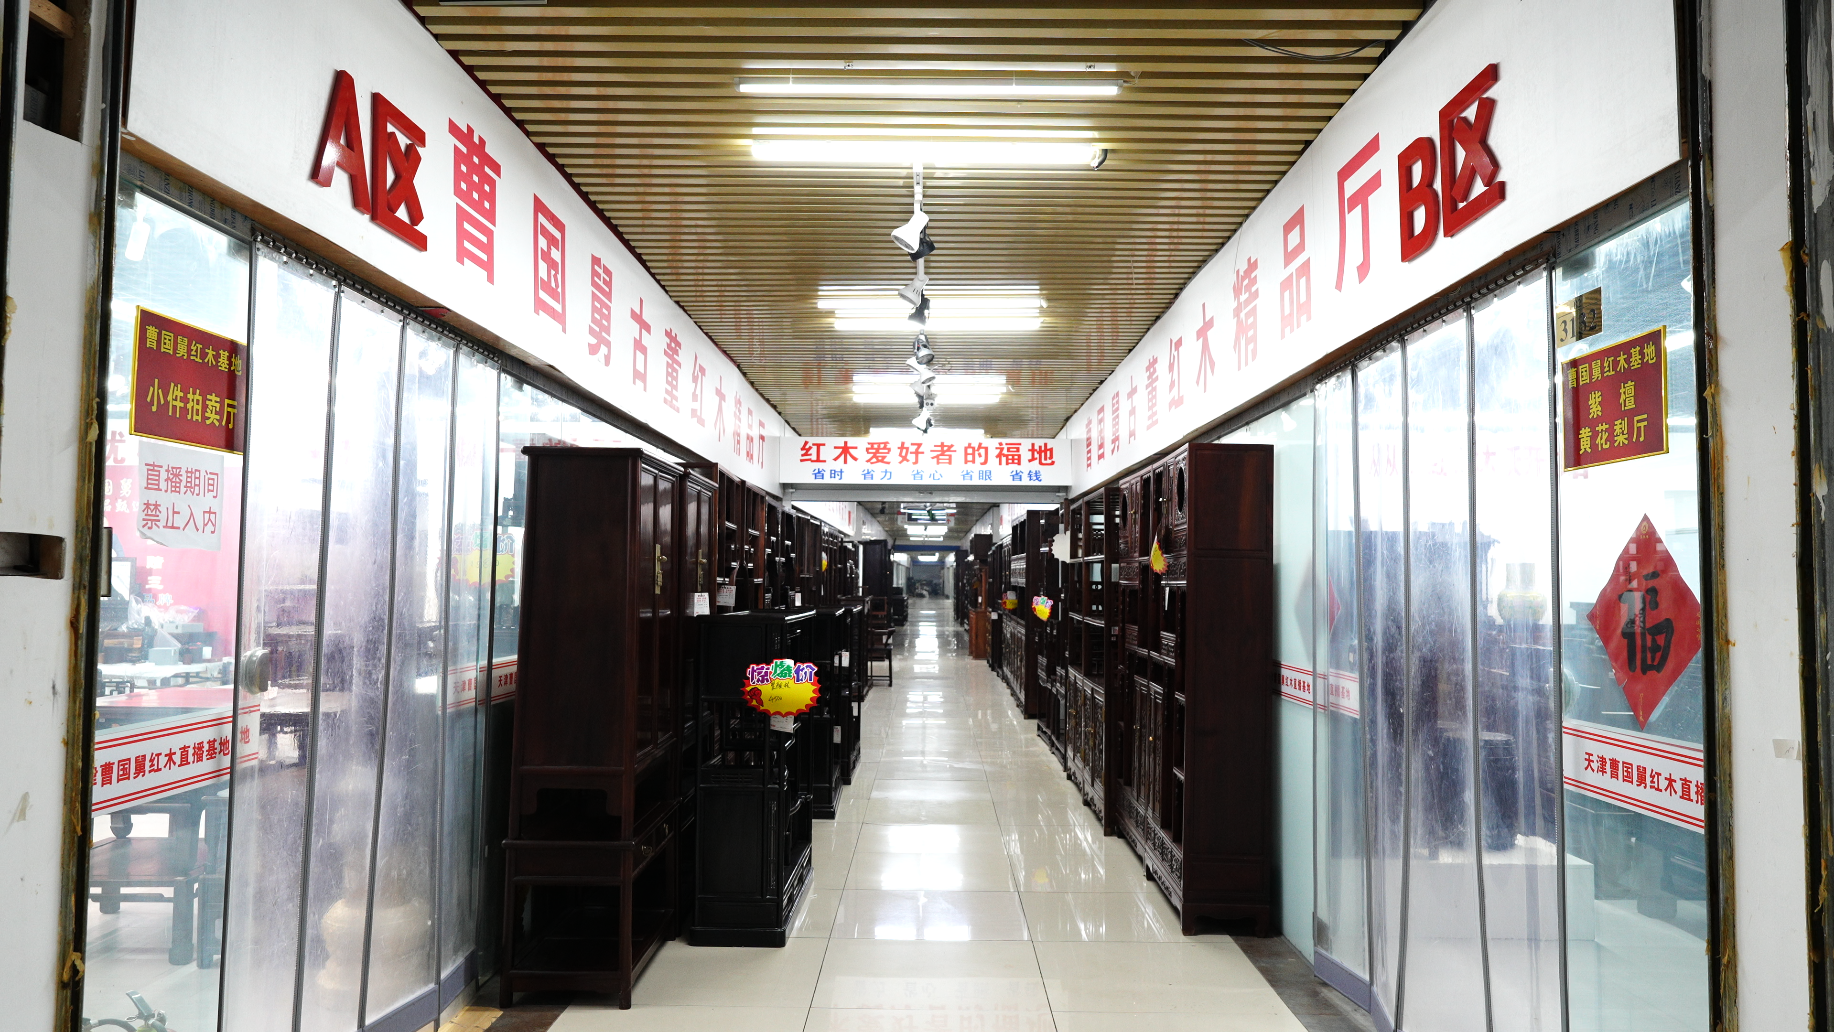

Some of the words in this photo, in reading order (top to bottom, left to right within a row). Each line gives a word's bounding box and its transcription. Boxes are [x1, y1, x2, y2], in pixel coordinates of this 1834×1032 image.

[311, 69, 428, 252] A区
[1398, 62, 1506, 263] B区
[448, 117, 765, 469] 曹国舅古董红木精品厅
[1085, 132, 1381, 472] 曹国舅古董红木精品厅
[146, 325, 242, 376] 曹国舅红木基地
[1568, 342, 1657, 389] 曹国舅红木基地
[147, 378, 238, 429] 小件拍卖厅
[800, 441, 1056, 466] 红木爱好者的福地
[1579, 414, 1648, 455] 黄花梨厅
[144, 462, 219, 499] 直播期间
[811, 468, 845, 480] 省时
[861, 469, 893, 481] 省力
[911, 469, 943, 481] 省心
[960, 469, 993, 481] 省眼
[1010, 469, 1043, 482] 省钱
[141, 500, 217, 534] 禁止入内
